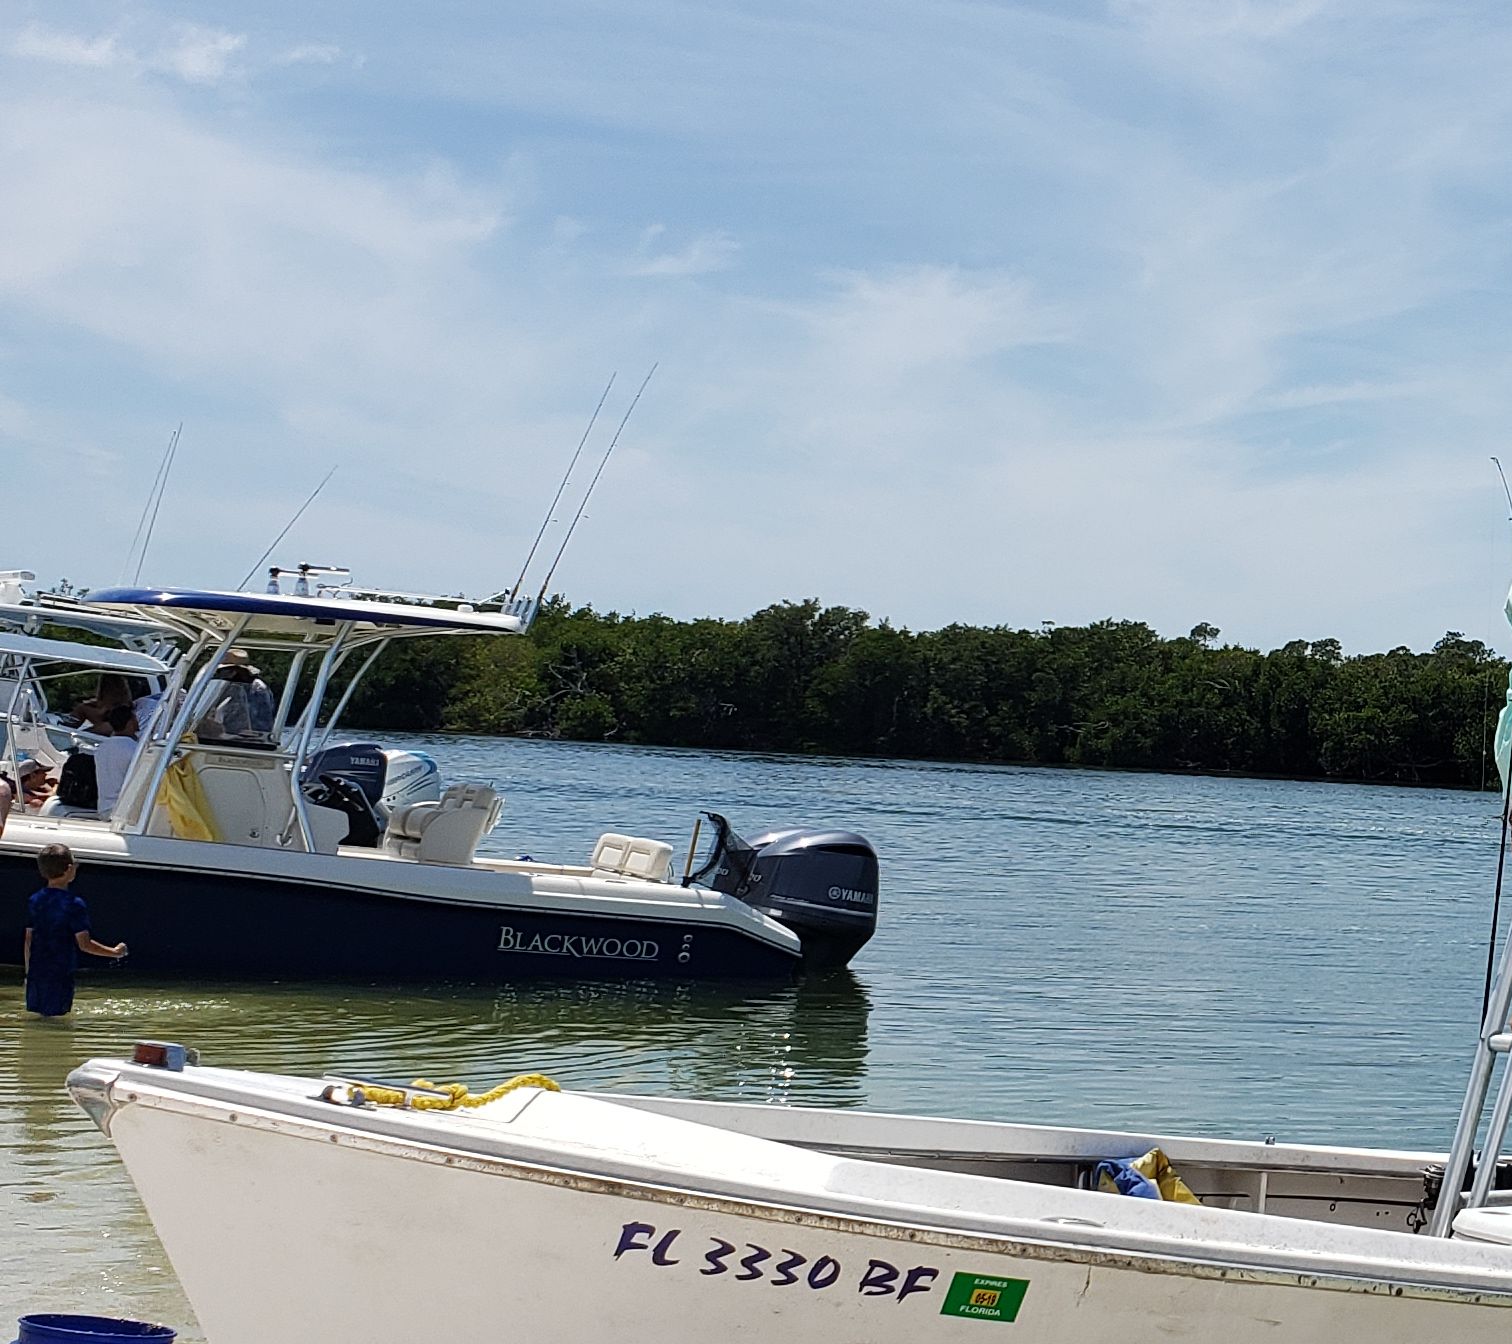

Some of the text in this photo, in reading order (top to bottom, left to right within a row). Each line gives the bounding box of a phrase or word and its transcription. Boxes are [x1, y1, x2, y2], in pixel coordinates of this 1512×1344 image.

[497, 926, 659, 959] BLACKWOOD
[613, 1221, 940, 1305] FL 3330 BF
[973, 1278, 1008, 1288] EXPIRES
[959, 1304, 1001, 1317] FLORIDA
